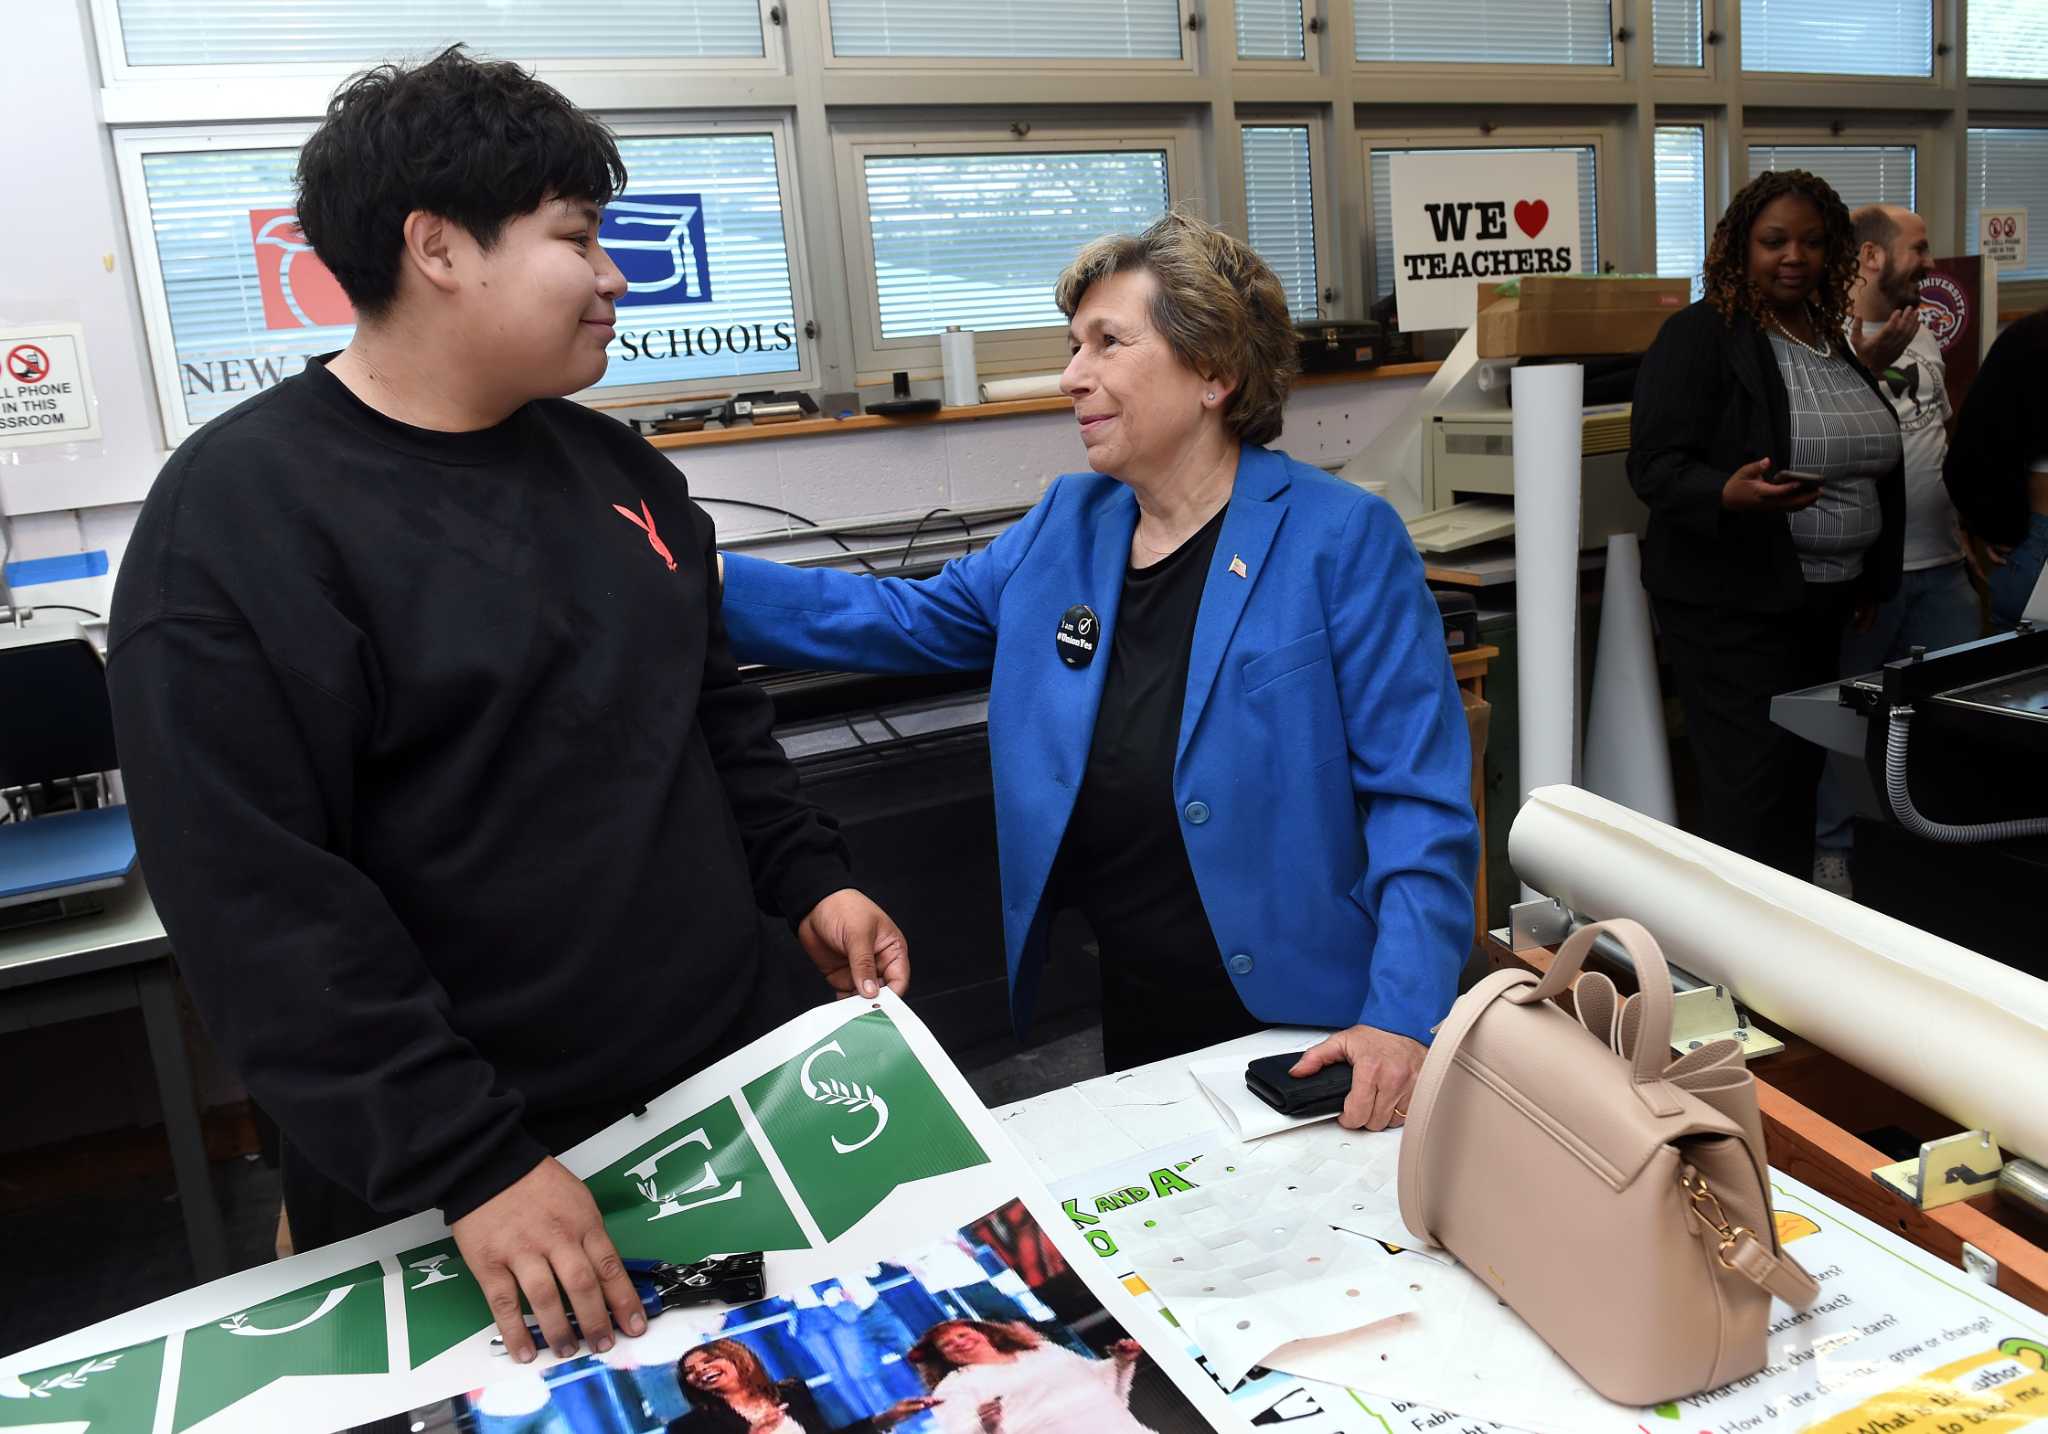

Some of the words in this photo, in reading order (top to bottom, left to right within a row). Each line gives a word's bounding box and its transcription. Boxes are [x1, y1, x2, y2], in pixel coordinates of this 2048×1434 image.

[1424, 201, 1507, 242] WE
[1404, 247, 1572, 280] TEACHERS
[181, 355, 288, 395] NEW
[620, 322, 792, 361] SCHOOLS
[17, 382, 72, 397] PHONE
[2, 402, 18, 413] IN
[22, 398, 57, 412] THIS
[1057, 632, 1093, 650] #UnionYes
[1094, 1186, 1150, 1213] AND
[1812, 1293, 1857, 1316] react?
[1888, 1344, 1924, 1365] grow
[1924, 1335, 1943, 1350] or
[1942, 1316, 1994, 1343] change?
[2015, 1386, 2046, 1403] me
